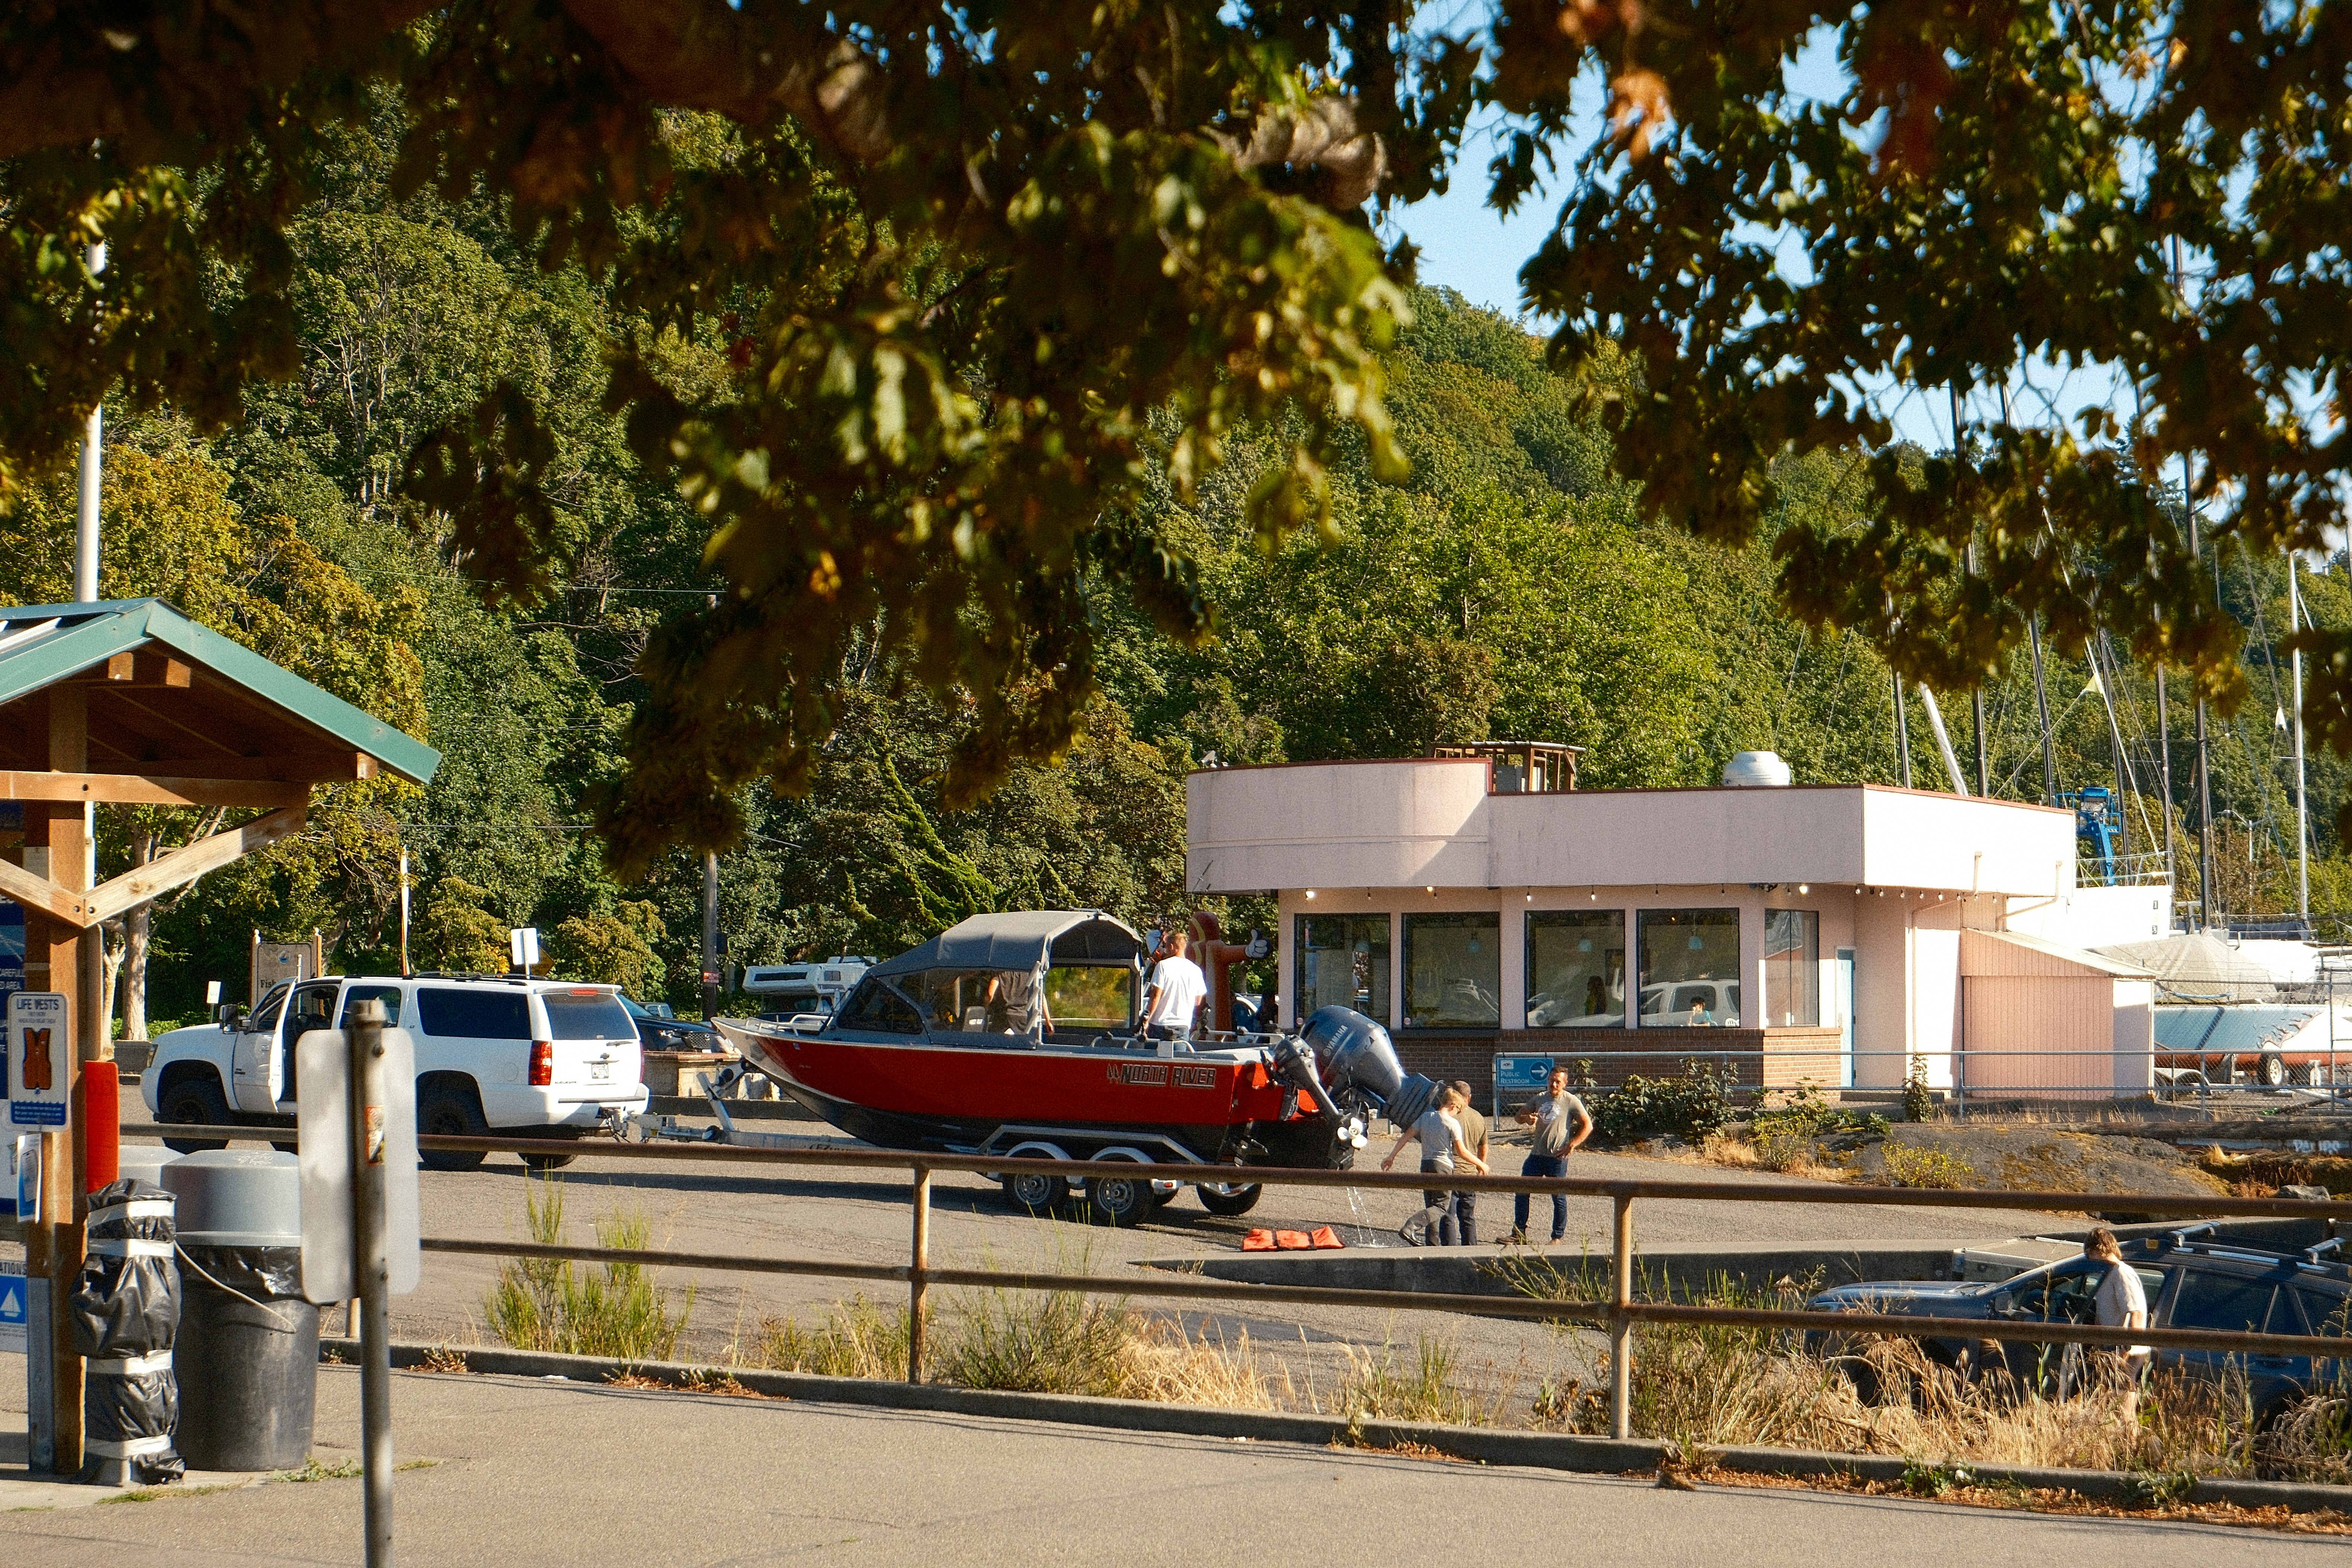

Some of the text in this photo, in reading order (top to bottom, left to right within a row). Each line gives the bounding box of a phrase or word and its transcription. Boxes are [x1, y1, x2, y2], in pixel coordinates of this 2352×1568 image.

[16, 998, 59, 1010] LIFE VESTS
[1326, 1025, 1348, 1050] YAMAHA
[1120, 1064, 1216, 1089] NORTH RIVER
